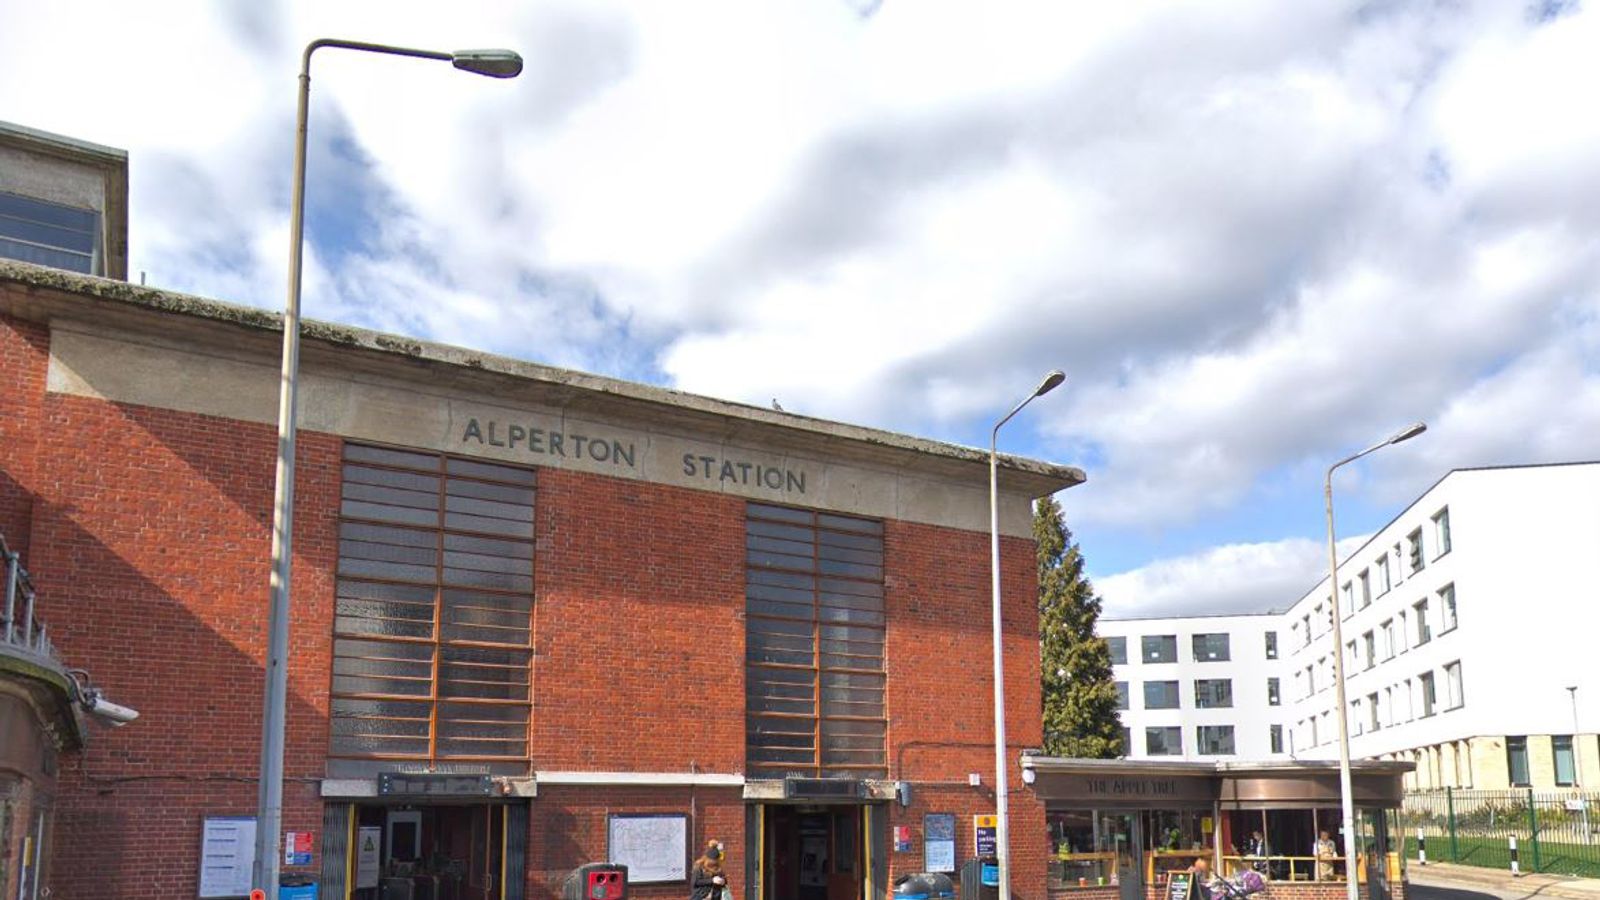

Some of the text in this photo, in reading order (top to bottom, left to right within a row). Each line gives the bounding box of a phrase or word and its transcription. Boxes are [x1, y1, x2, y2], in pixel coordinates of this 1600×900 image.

[463, 418, 806, 493] ALPERTON STATION
[1113, 780, 1146, 794] APPLE
[1151, 780, 1177, 795] TREE
